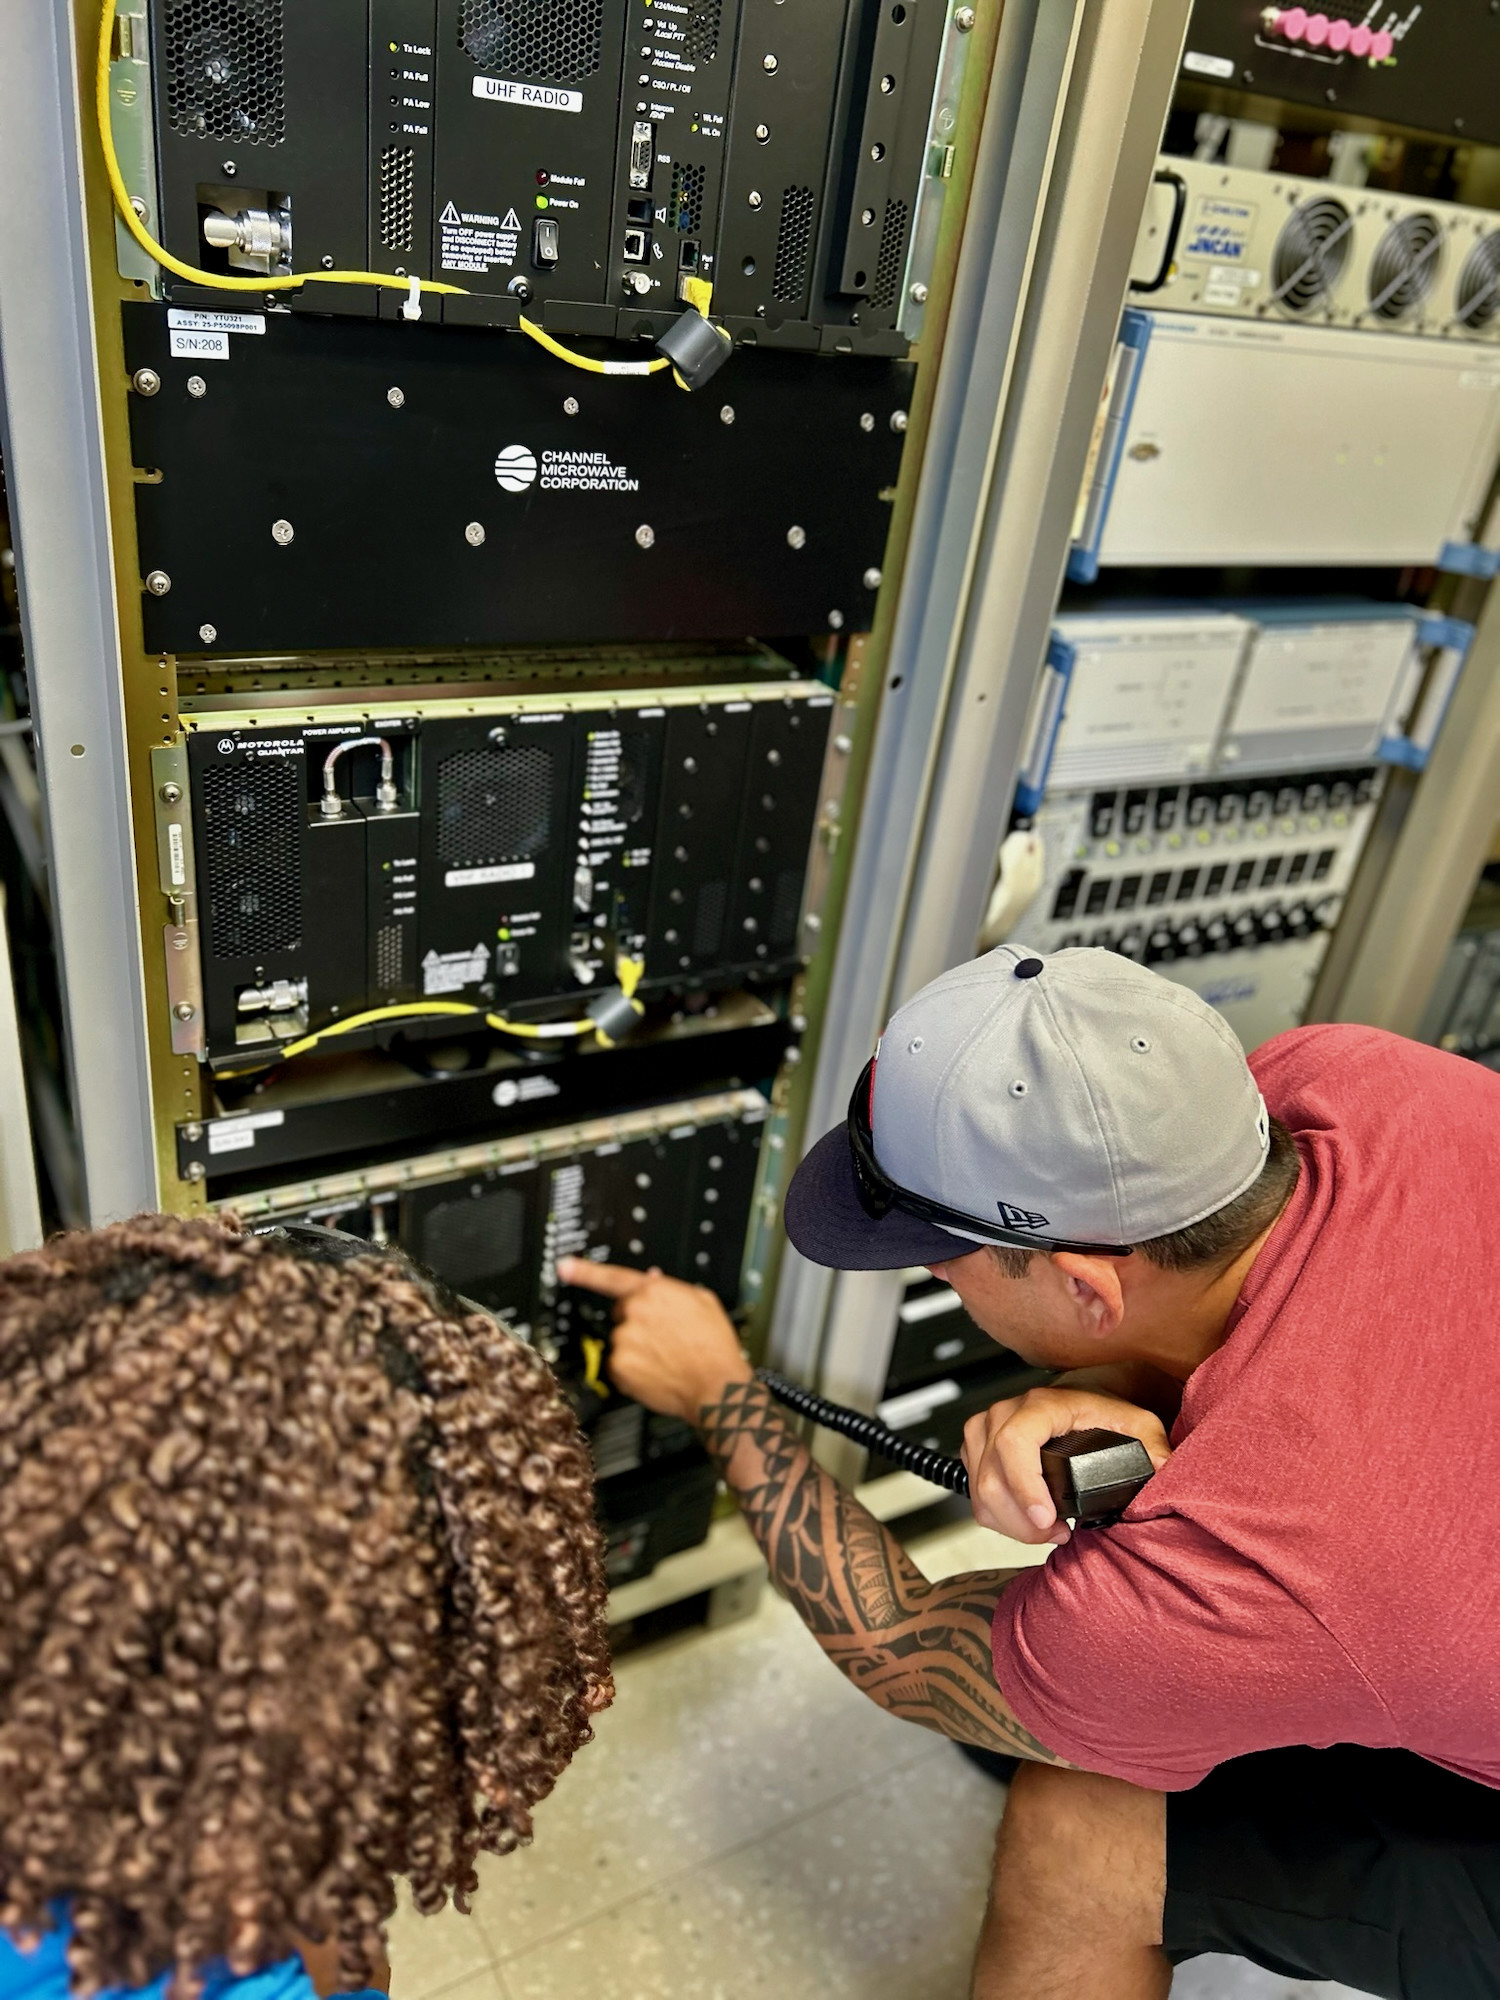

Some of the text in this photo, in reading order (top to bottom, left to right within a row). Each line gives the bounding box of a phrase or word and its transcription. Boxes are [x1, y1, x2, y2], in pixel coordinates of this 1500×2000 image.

[668, 22, 678, 32] Up
[672, 32, 686, 41] PTT
[403, 43, 431, 56] Tx Lock
[664, 51, 681, 61] Down
[403, 70, 428, 82] PA Full
[486, 81, 570, 106] UHF RADIO
[403, 97, 430, 109] PA Low
[403, 124, 428, 135] PA Fail
[711, 128, 721, 137] On
[657, 154, 671, 164] RSS
[550, 174, 586, 186] Module Fail
[549, 197, 579, 209] Power On
[460, 213, 500, 226] WARNING
[441, 226, 458, 235] Turn
[458, 227, 474, 237] OFF
[454, 236, 496, 247] DISCONNECT
[194, 312, 242, 322] P/N: YTU321
[176, 319, 200, 327] ASSY:
[176, 337, 223, 351] S/N:208
[541, 450, 611, 465] CHANNEL
[541, 464, 627, 478] MICROWAVE
[540, 477, 639, 491] CORPORATION
[302, 726, 362, 737] POWER AMPLIFIER
[236, 739, 305, 749] MOTOROLA
[257, 746, 305, 757] QUANTAR
